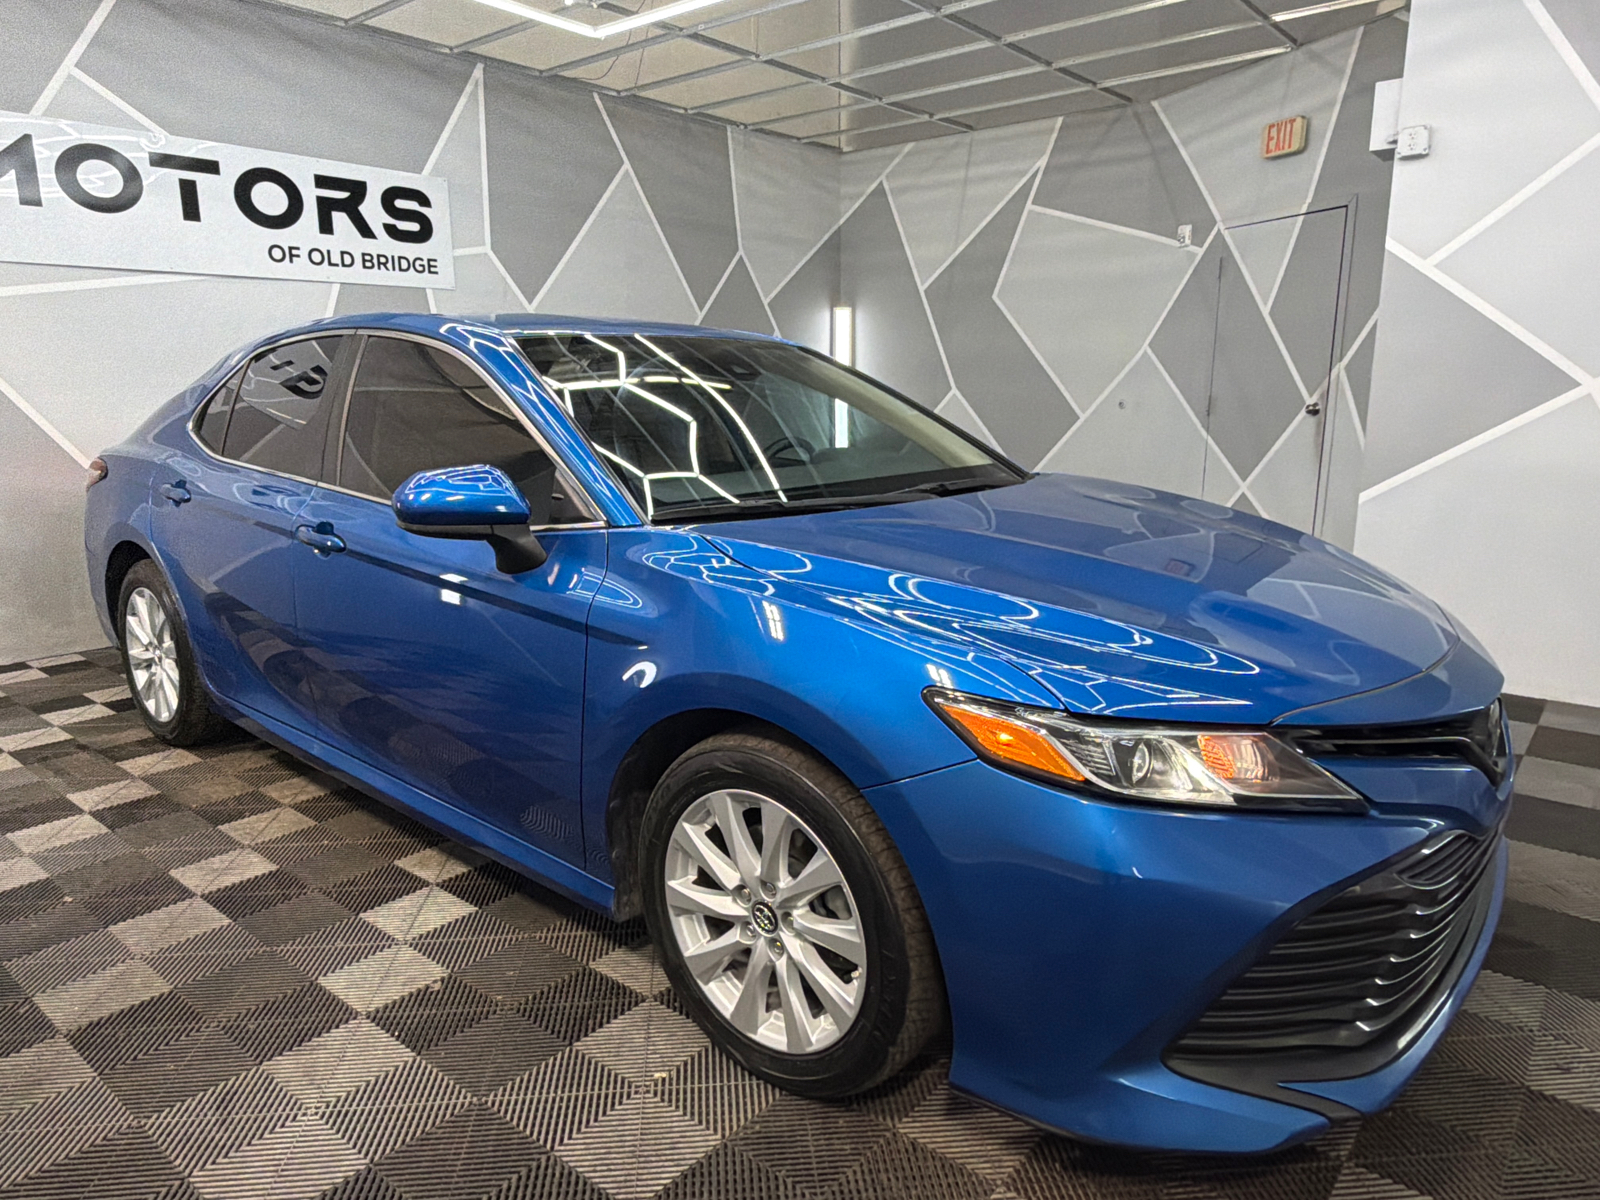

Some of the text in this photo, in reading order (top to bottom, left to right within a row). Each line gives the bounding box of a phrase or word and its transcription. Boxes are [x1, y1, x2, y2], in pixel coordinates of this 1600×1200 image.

[1265, 118, 1297, 155] EXIT
[267, 244, 439, 275] OF OLD BRIDGE
